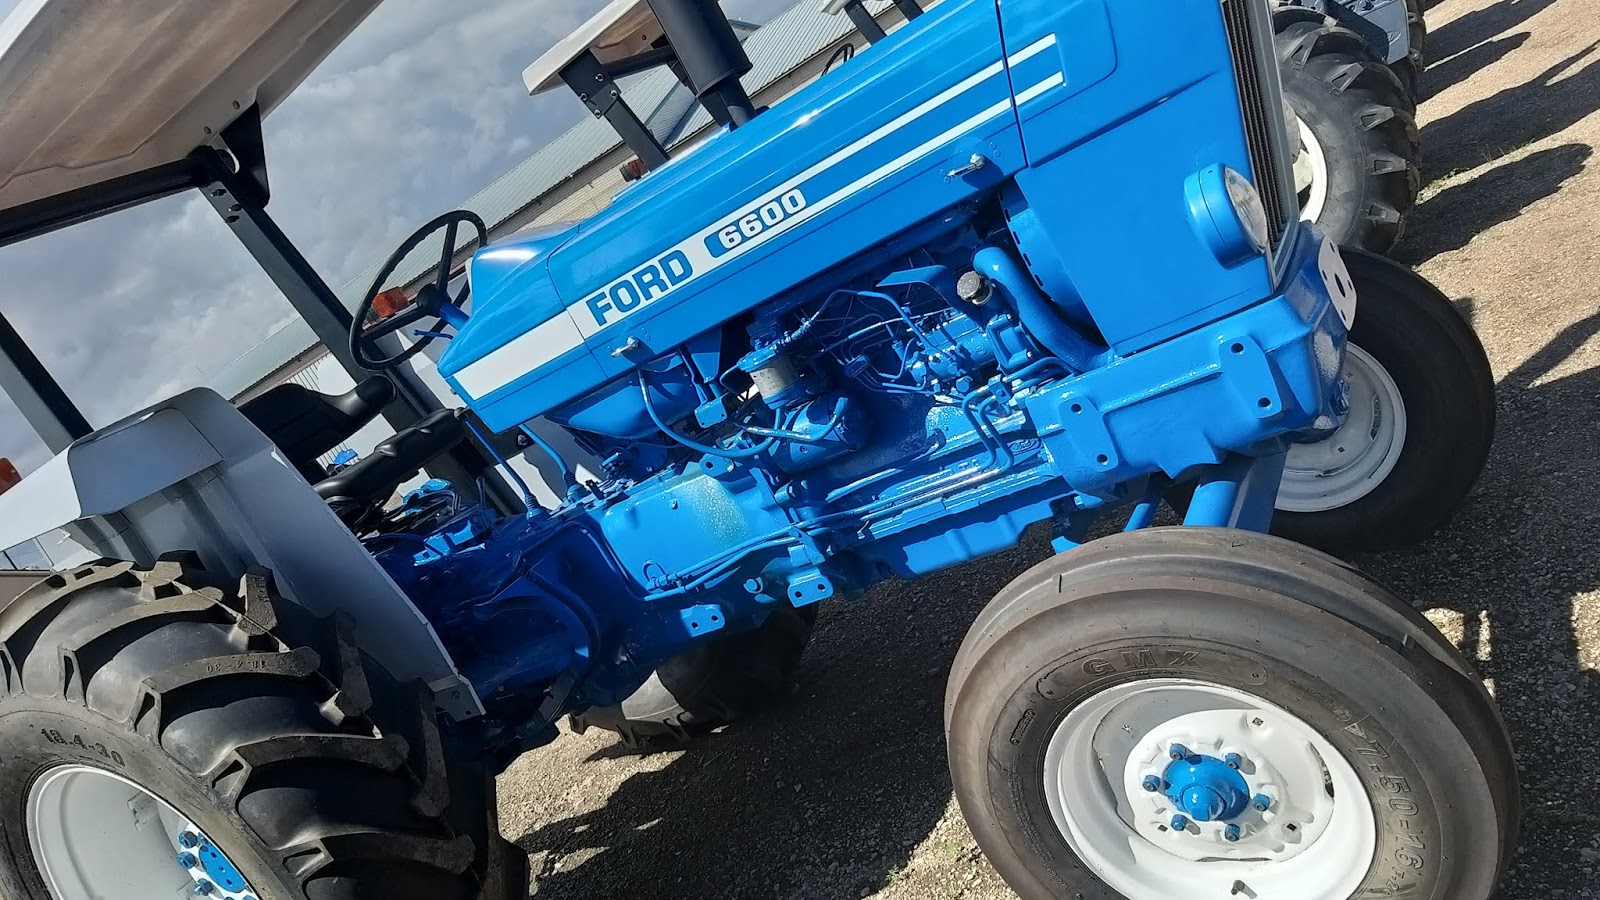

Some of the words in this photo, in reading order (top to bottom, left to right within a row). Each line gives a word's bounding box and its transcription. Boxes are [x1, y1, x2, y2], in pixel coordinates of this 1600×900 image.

[585, 249, 693, 326] FORD
[718, 188, 807, 249] 6600
[1082, 650, 1202, 676] GMX
[41, 728, 126, 767] 18.4-30
[1356, 740, 1426, 869] 7.50-16
